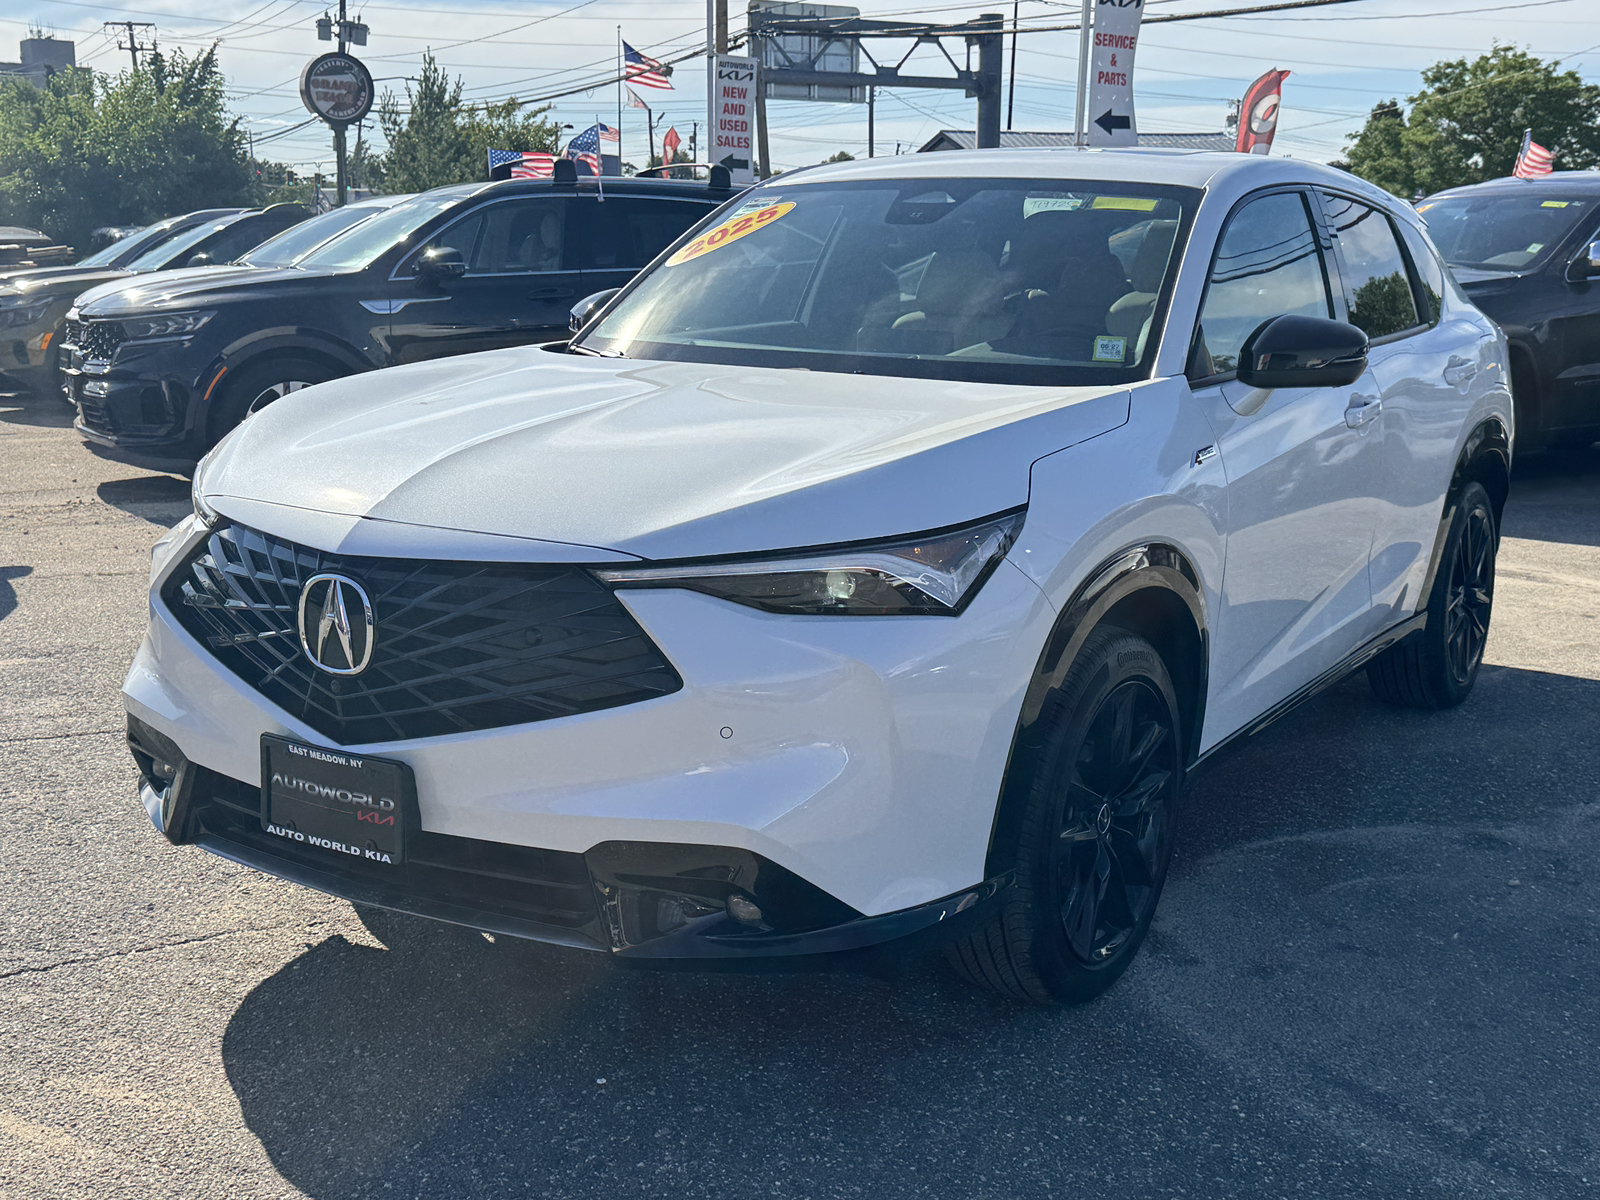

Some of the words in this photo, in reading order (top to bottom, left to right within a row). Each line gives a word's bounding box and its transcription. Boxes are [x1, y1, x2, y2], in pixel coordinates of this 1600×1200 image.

[1095, 32, 1136, 50] SERVICE
[718, 60, 755, 71] AUTOWORLD
[1110, 53, 1118, 67] &
[718, 69, 754, 82] KIA
[1097, 71, 1127, 87] PARTS
[722, 86, 748, 100] NEW
[722, 103, 746, 116] AND
[719, 118, 748, 132] USED
[716, 135, 750, 149] SALES
[682, 205, 780, 261] 2025
[288, 744, 308, 757] EAST
[350, 759, 363, 769] NY
[271, 772, 395, 812] AUTOWORLD
[357, 810, 395, 826] KIA
[266, 824, 305, 841] AUTO
[308, 835, 361, 856] WORLD
[365, 849, 392, 865] KIA
